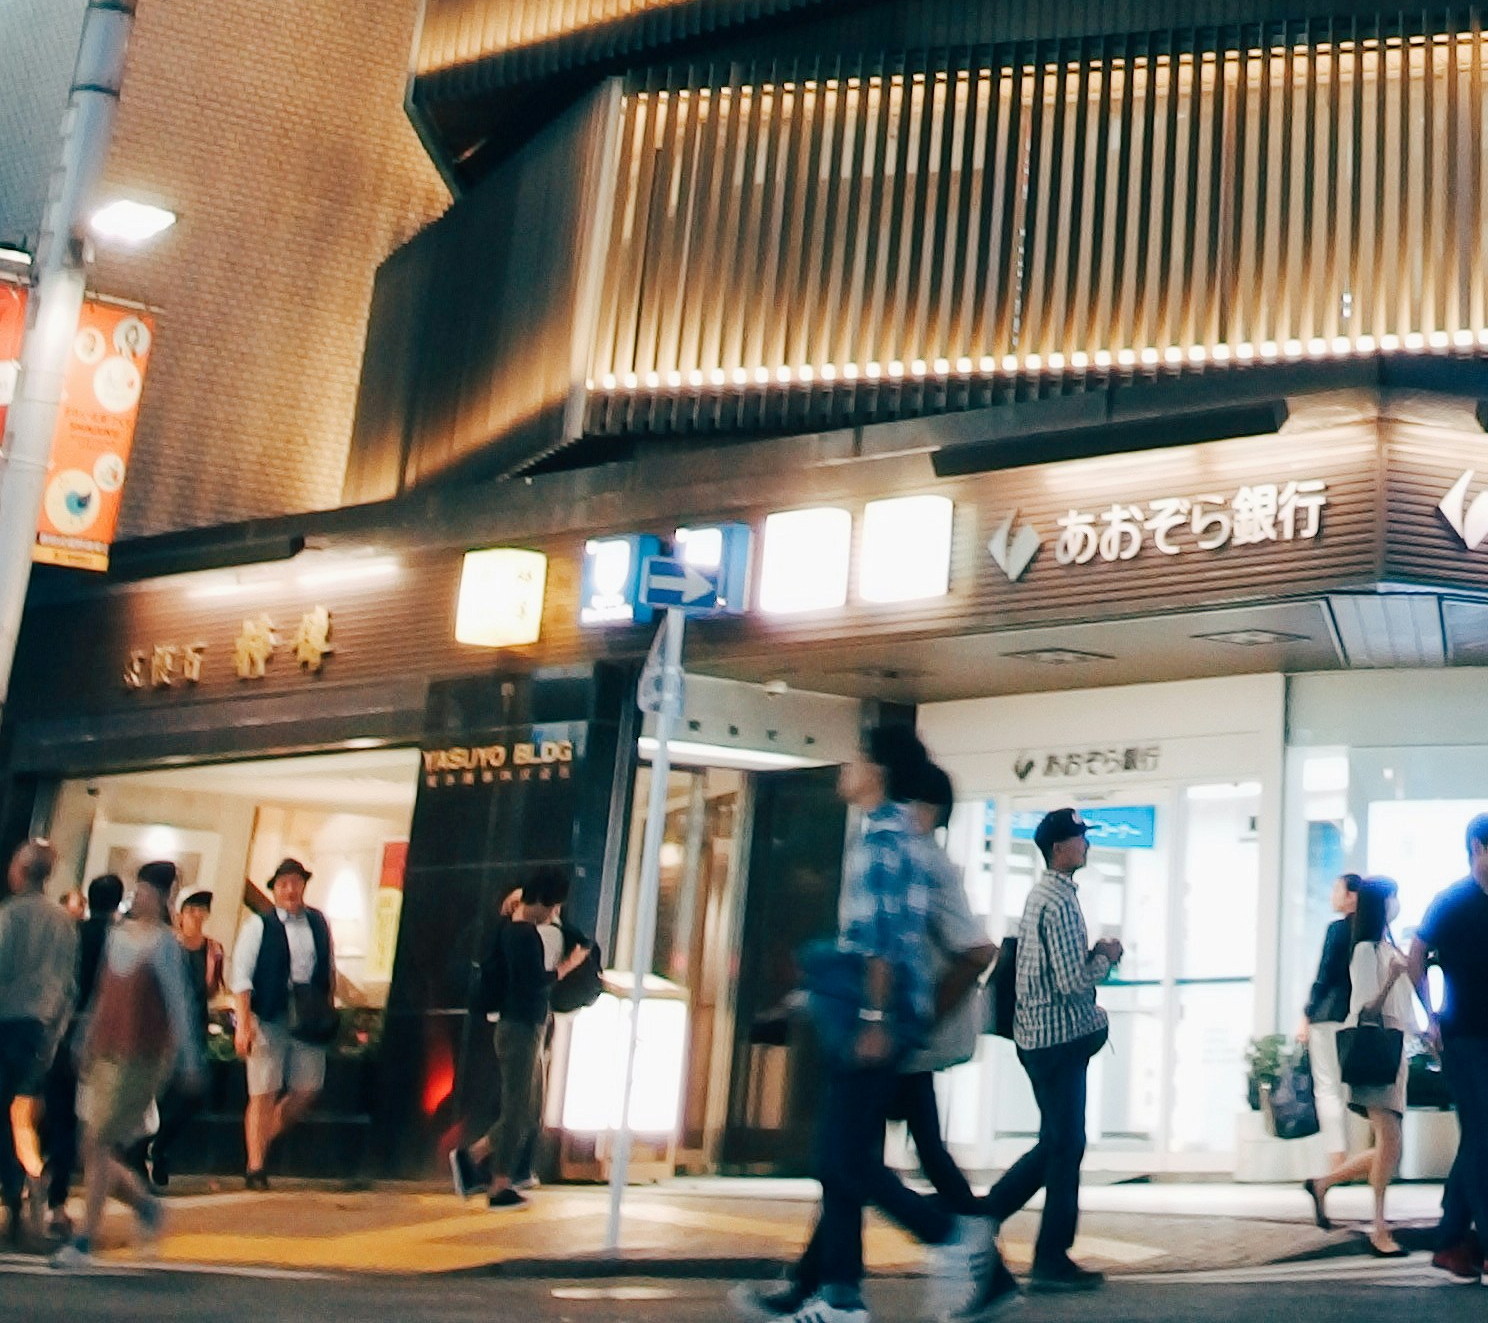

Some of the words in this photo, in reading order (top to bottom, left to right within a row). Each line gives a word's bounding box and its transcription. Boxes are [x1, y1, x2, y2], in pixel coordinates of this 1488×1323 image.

[1055, 480, 1327, 565] あおぞら銀行
